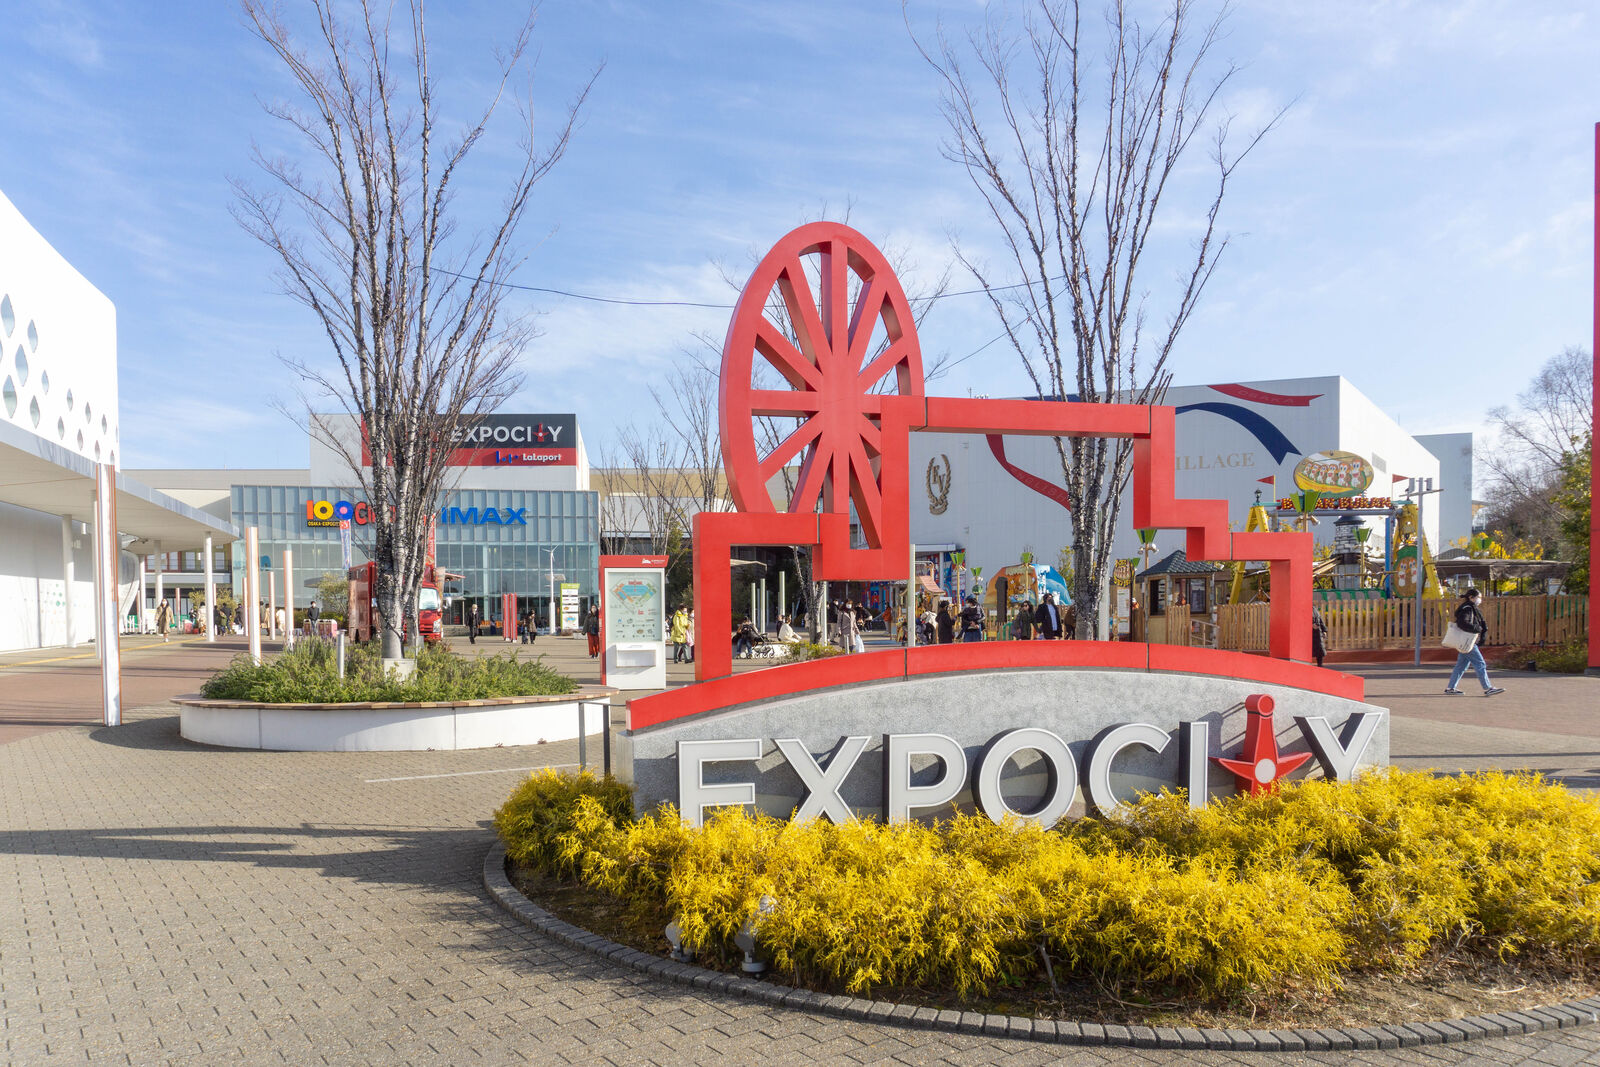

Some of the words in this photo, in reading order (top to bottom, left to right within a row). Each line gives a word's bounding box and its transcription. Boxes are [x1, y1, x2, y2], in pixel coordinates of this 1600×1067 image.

[522, 453, 561, 462] LaLaport
[1175, 452, 1255, 471] ILLAGE
[441, 506, 528, 526] IMAX
